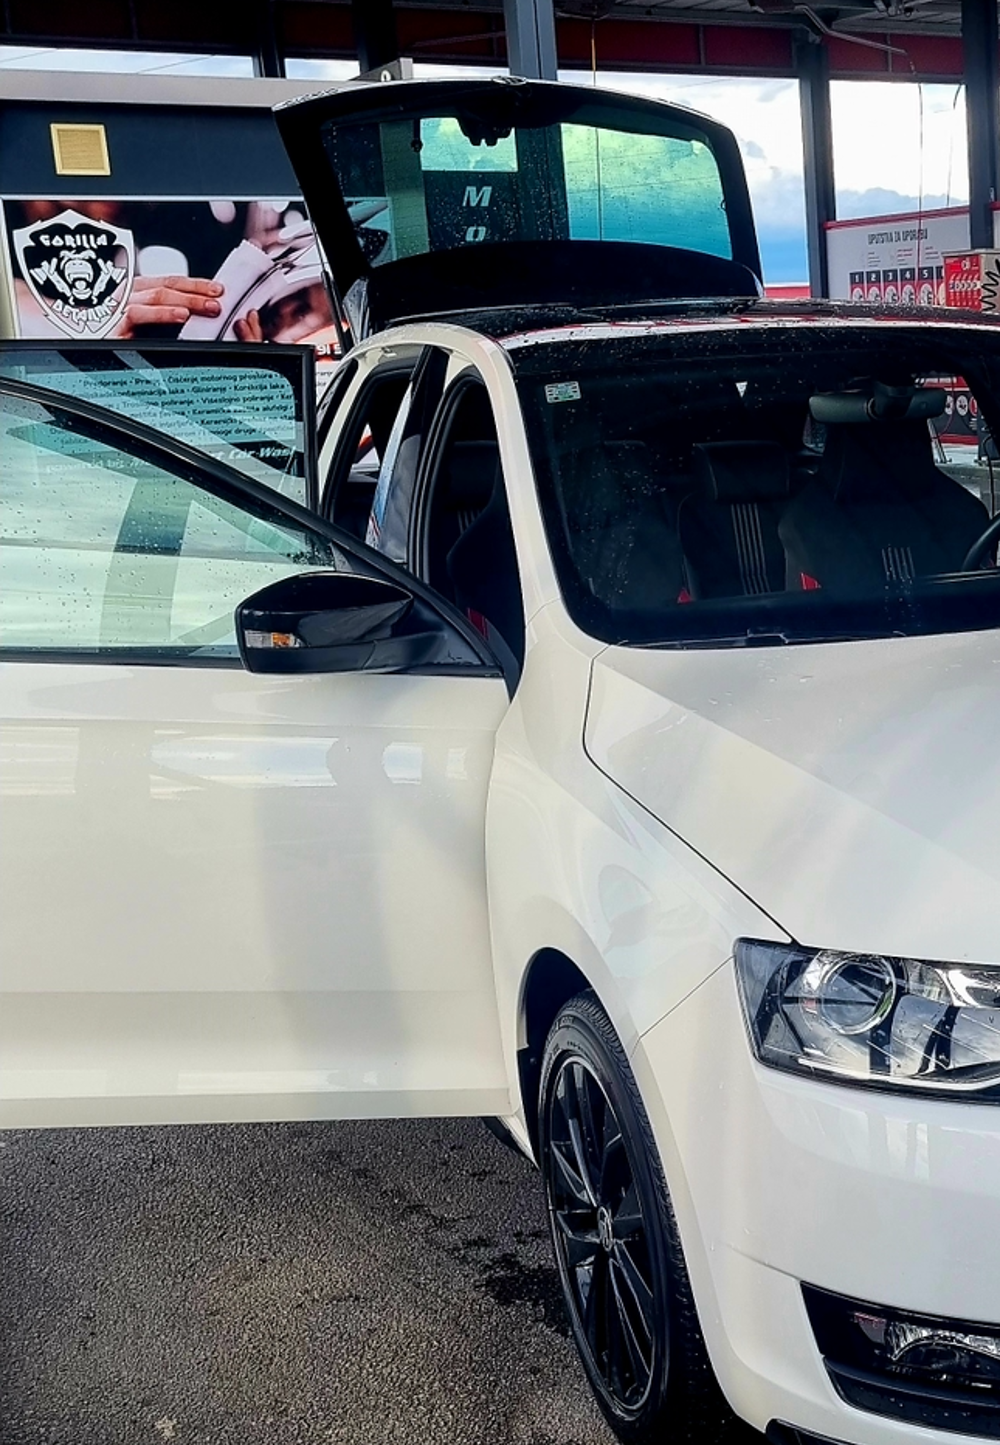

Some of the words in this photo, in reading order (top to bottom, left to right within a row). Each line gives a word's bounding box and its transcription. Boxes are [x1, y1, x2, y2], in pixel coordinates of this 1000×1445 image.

[39, 233, 108, 249] GORILLA
[855, 274, 859, 283] 1
[871, 273, 876, 281] 2
[887, 272, 893, 280] 3
[904, 271, 911, 279] 4
[922, 270, 928, 278] 5
[200, 373, 238, 383] motornog
